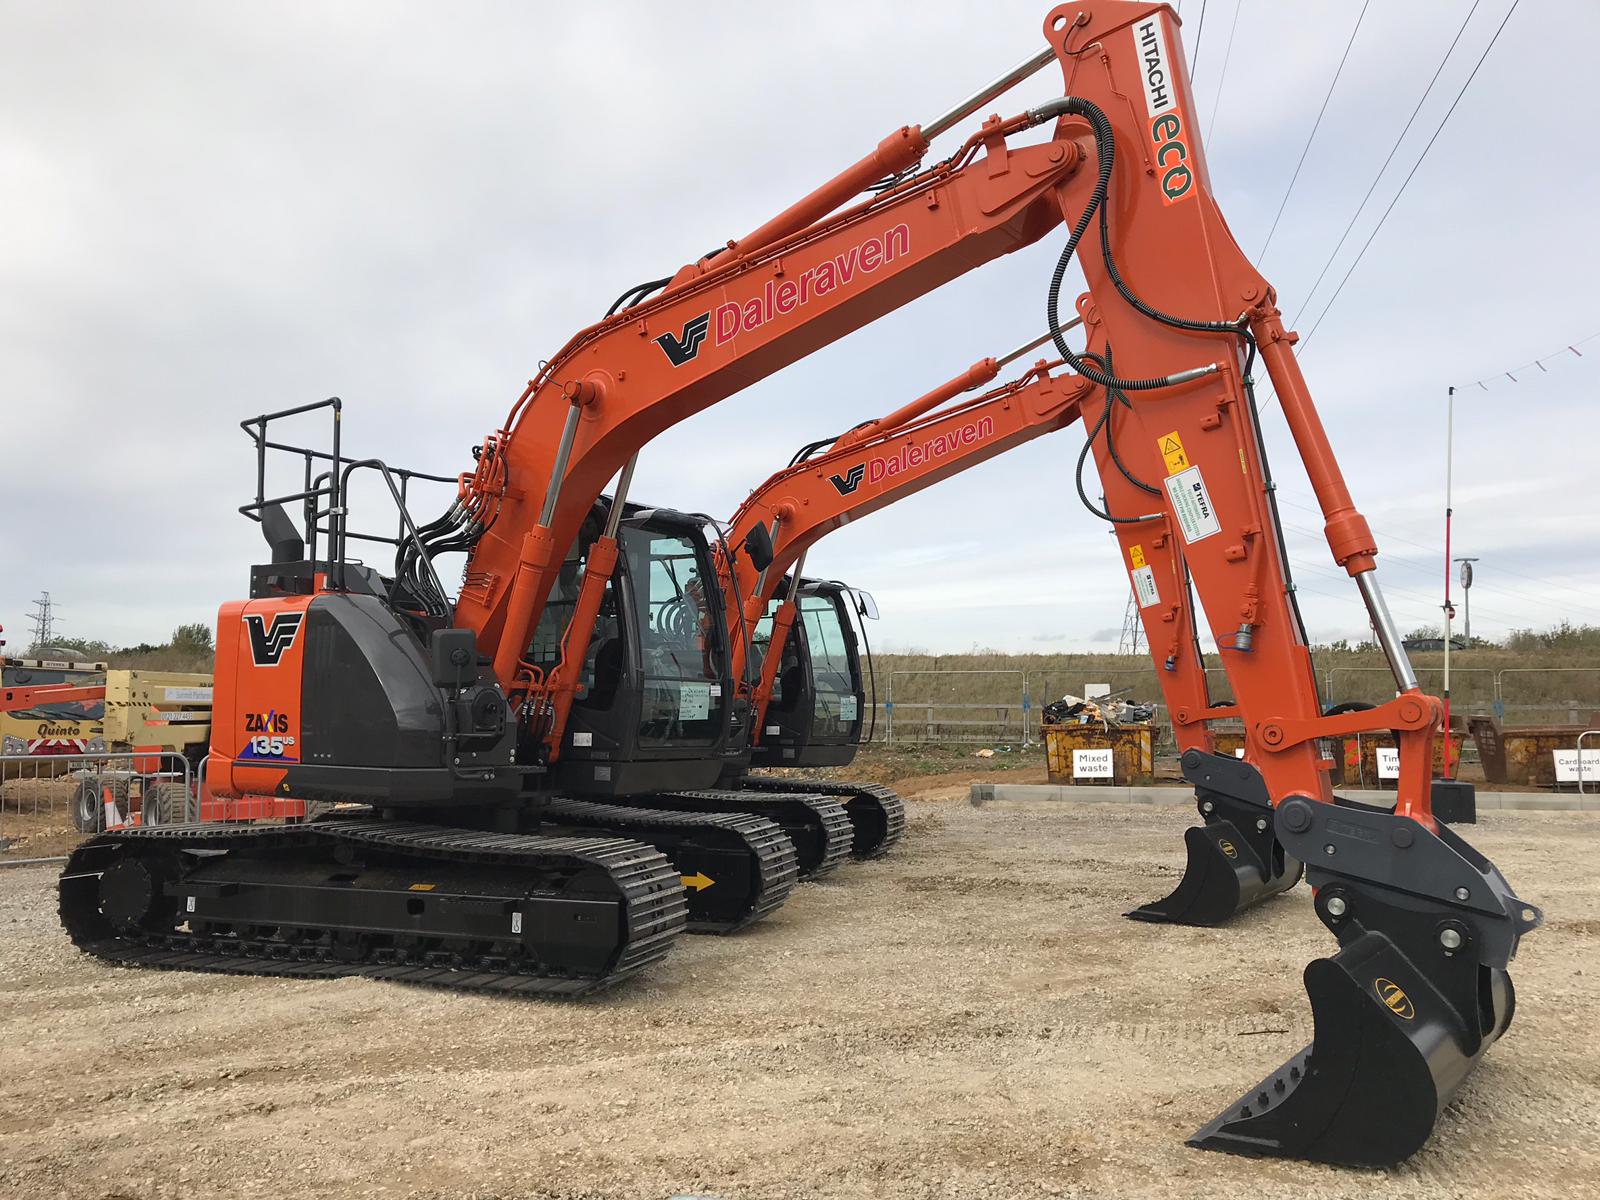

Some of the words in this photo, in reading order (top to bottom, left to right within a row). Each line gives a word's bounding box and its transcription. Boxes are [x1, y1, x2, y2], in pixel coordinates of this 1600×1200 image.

[1139, 22, 1168, 109] HITACHI
[716, 223, 910, 347] Daleraven
[869, 416, 994, 485] Daleraven
[1196, 492, 1210, 519] TEFRA
[38, 724, 80, 738] Quinto
[245, 709, 288, 733] ZAXIS
[1079, 754, 1108, 762] Mixed
[1079, 764, 1108, 772] waste
